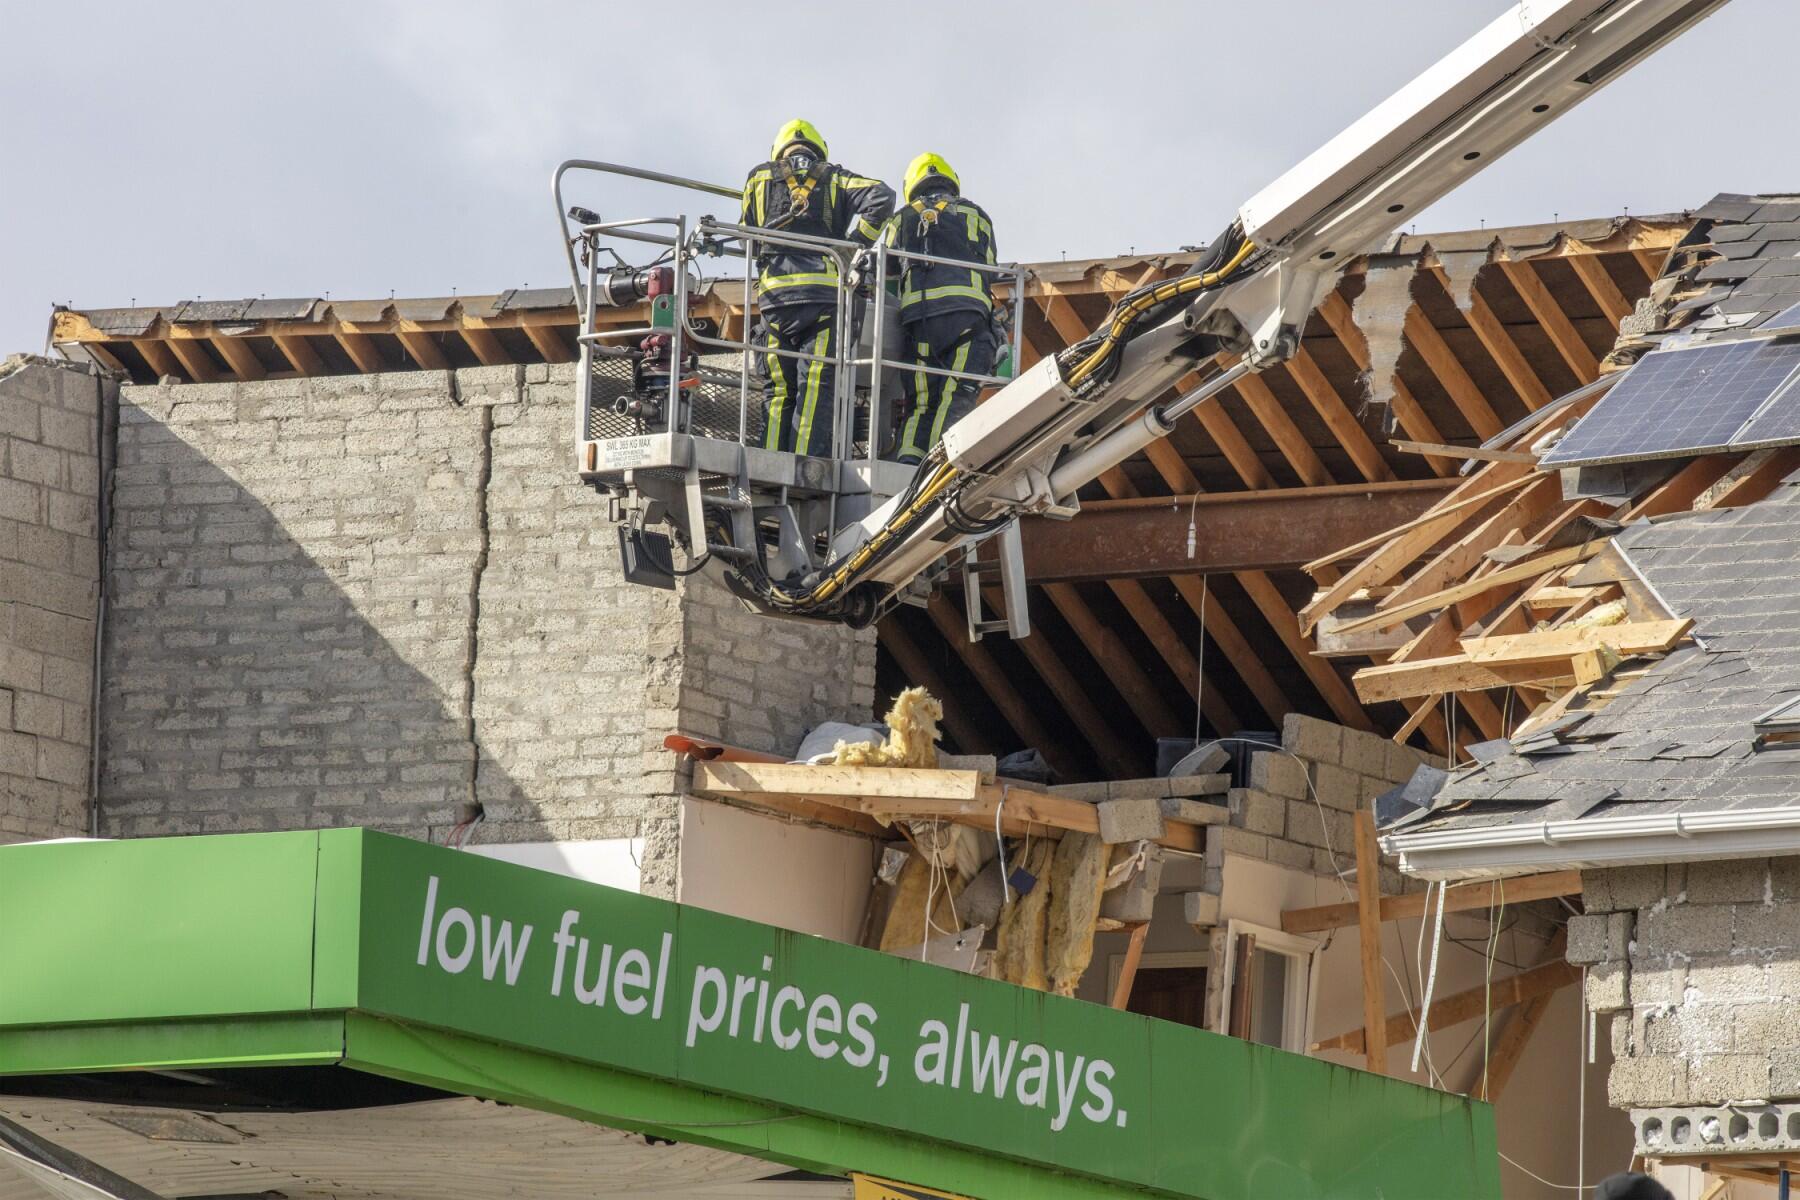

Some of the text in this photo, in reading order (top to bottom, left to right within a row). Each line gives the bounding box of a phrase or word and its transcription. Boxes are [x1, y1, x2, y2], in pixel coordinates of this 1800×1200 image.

[606, 440, 618, 451] SWL
[629, 439, 638, 448] KG
[639, 438, 651, 448] MAX
[416, 875, 1128, 1132] low fuel prices, always.
